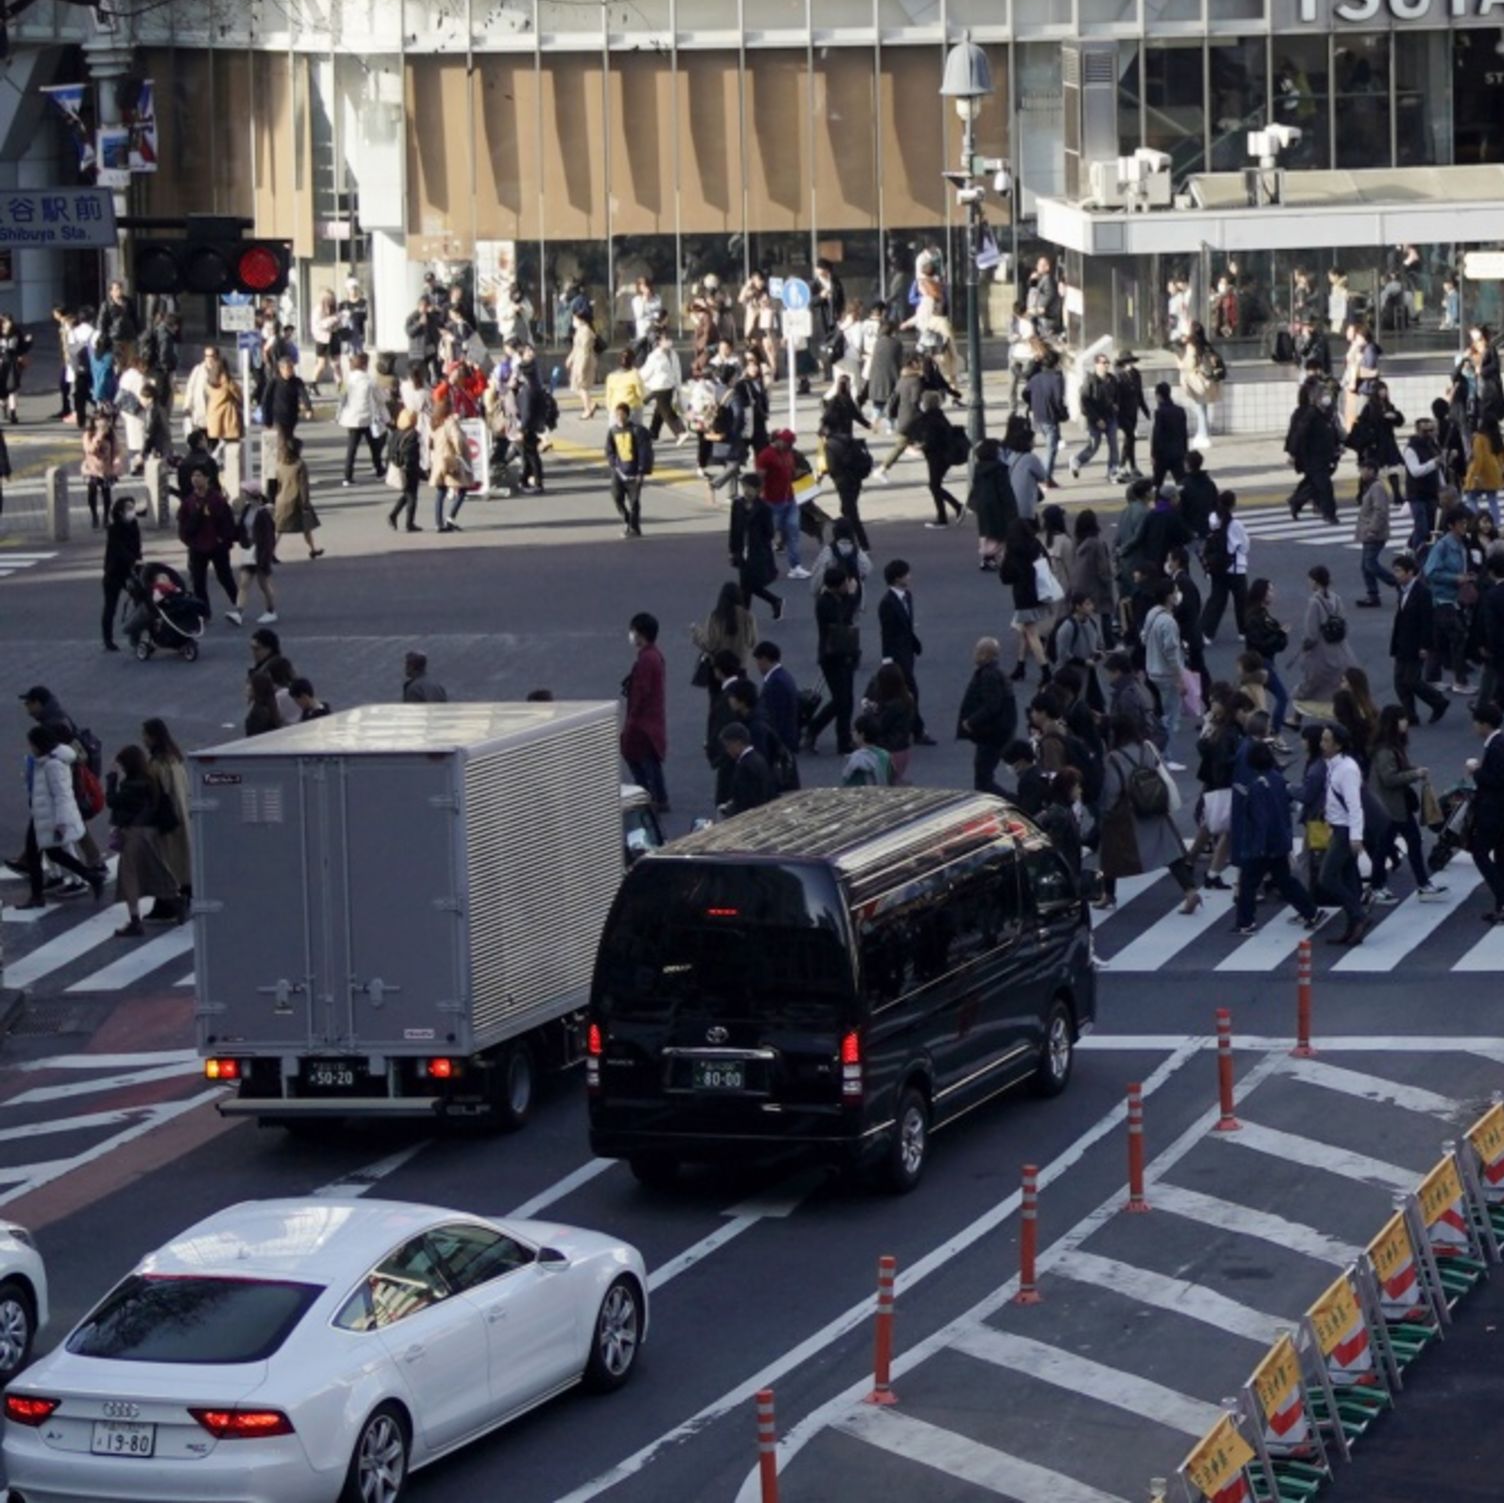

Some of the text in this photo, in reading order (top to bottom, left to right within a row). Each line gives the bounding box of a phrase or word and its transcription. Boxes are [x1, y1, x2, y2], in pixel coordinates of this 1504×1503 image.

[0, 195, 102, 223] 谷駅前
[0, 225, 55, 243] Shibuya
[107, 1434, 150, 1453] 19-80
